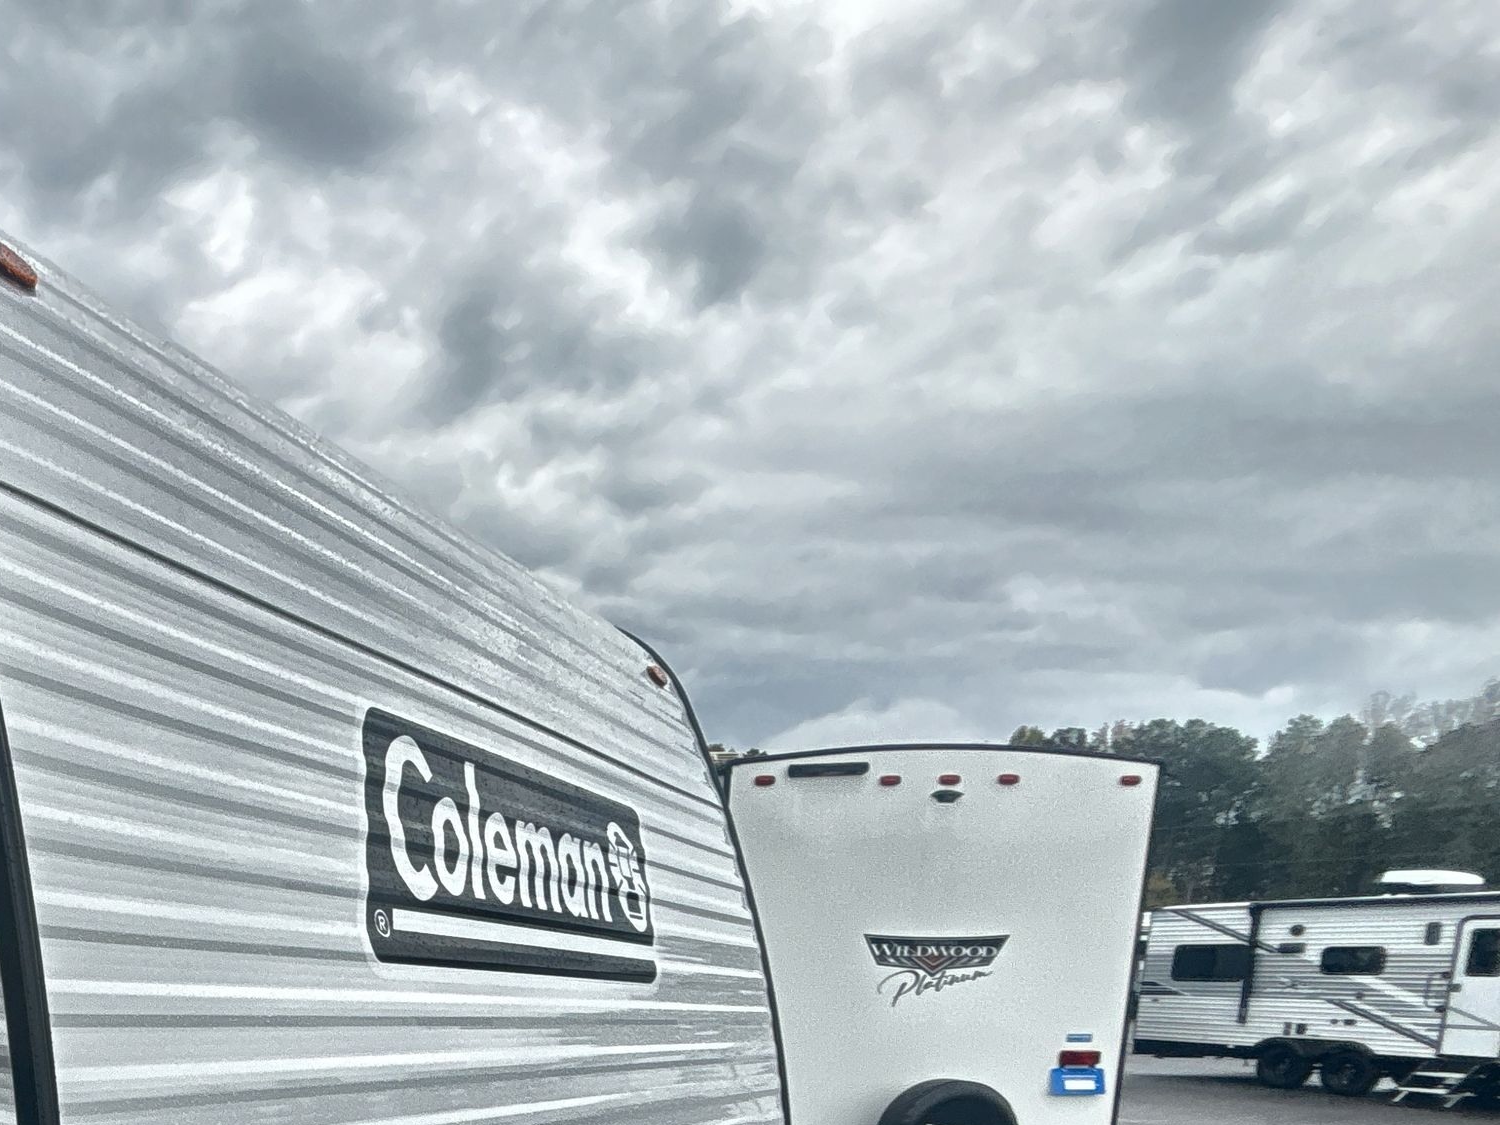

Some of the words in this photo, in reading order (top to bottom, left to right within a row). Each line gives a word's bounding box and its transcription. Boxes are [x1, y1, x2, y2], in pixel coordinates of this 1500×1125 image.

[383, 735, 613, 922] Coleman
[871, 943, 998, 957] WILDWOOD
[877, 970, 994, 1007] Platinum
